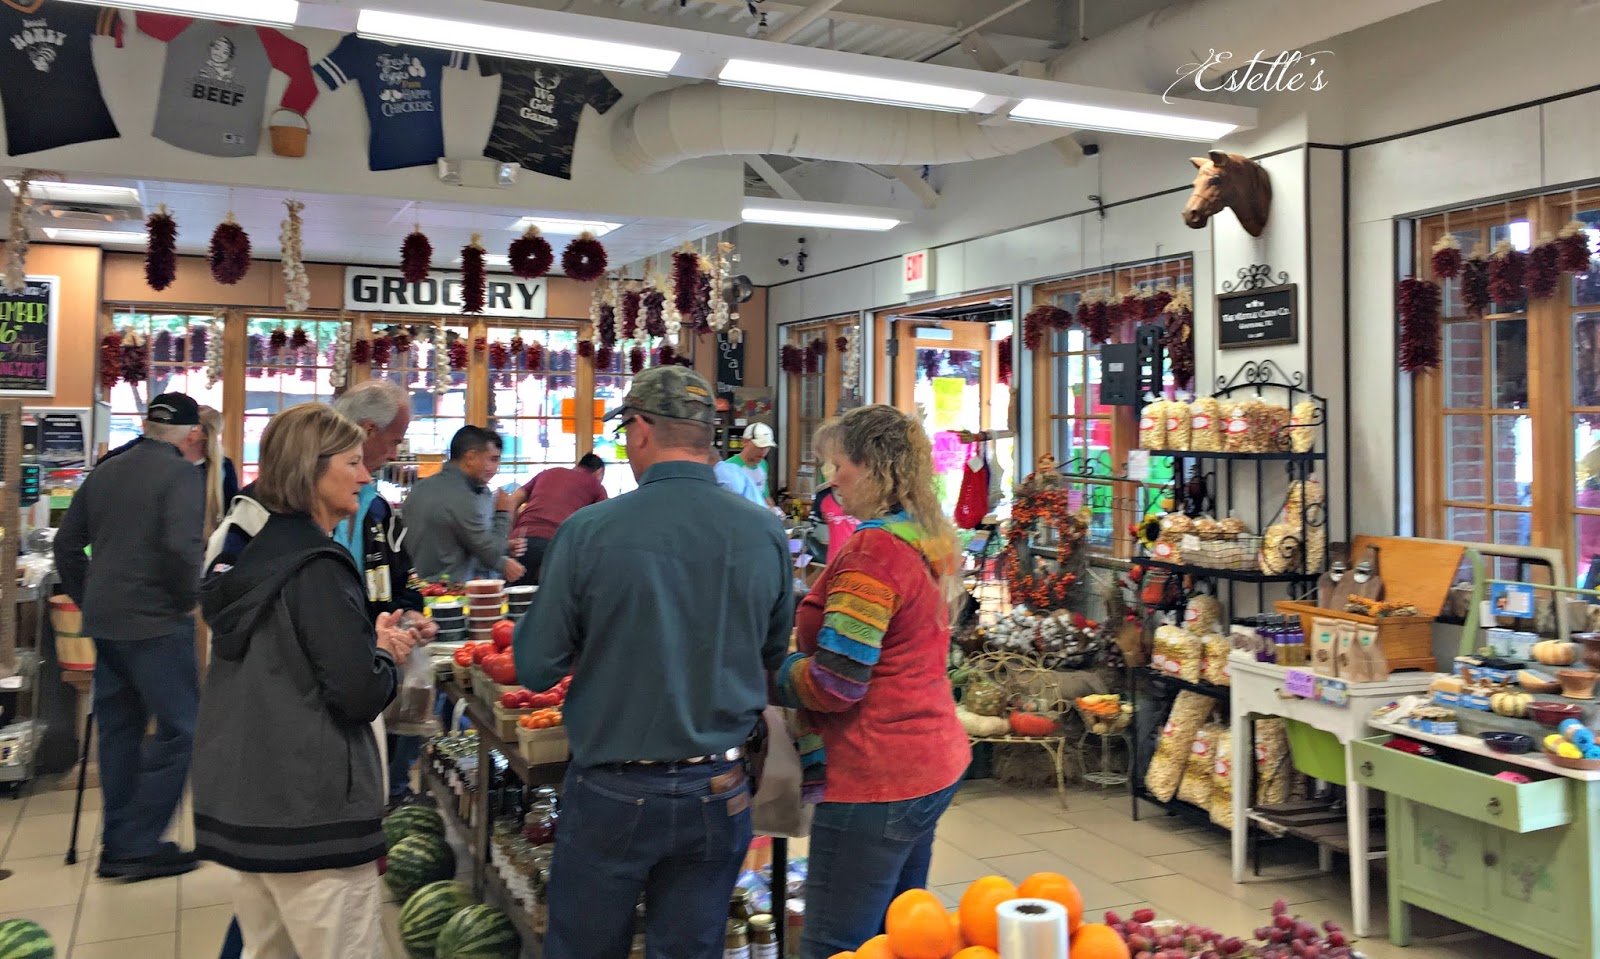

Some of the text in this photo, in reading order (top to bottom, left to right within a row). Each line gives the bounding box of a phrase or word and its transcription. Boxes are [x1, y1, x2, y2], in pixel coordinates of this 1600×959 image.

[192, 83, 244, 106] BEEF
[534, 86, 555, 102] We
[530, 98, 554, 113] Got
[520, 107, 558, 126] Game
[906, 253, 923, 281] EXIT
[353, 275, 540, 310] GROCRY
